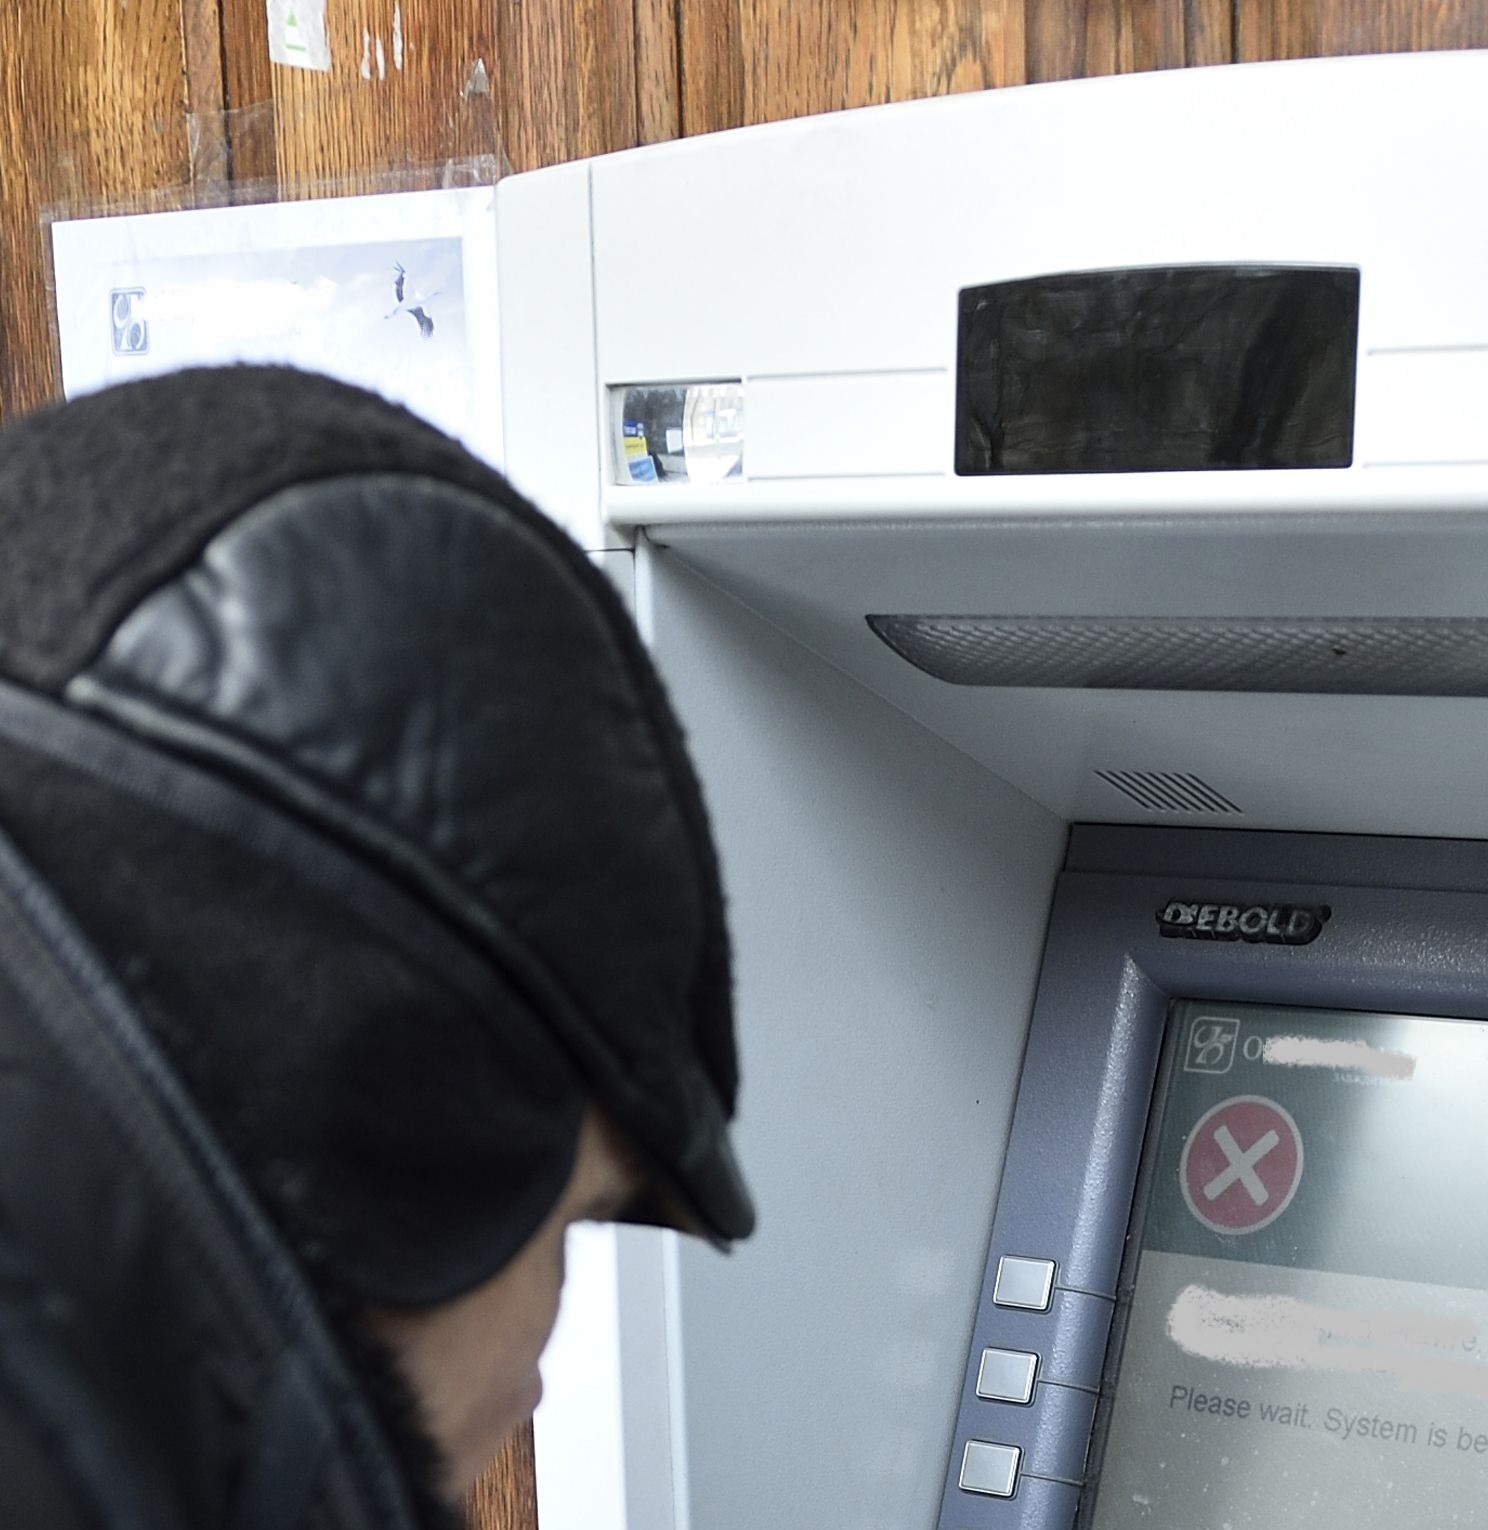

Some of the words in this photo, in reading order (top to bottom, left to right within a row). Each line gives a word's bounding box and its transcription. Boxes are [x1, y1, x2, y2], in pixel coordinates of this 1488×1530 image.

[1169, 1385, 1251, 1418] Please
[1260, 1402, 1312, 1429] wait.
[1323, 1407, 1418, 1443] System
[1427, 1421, 1448, 1448] is
